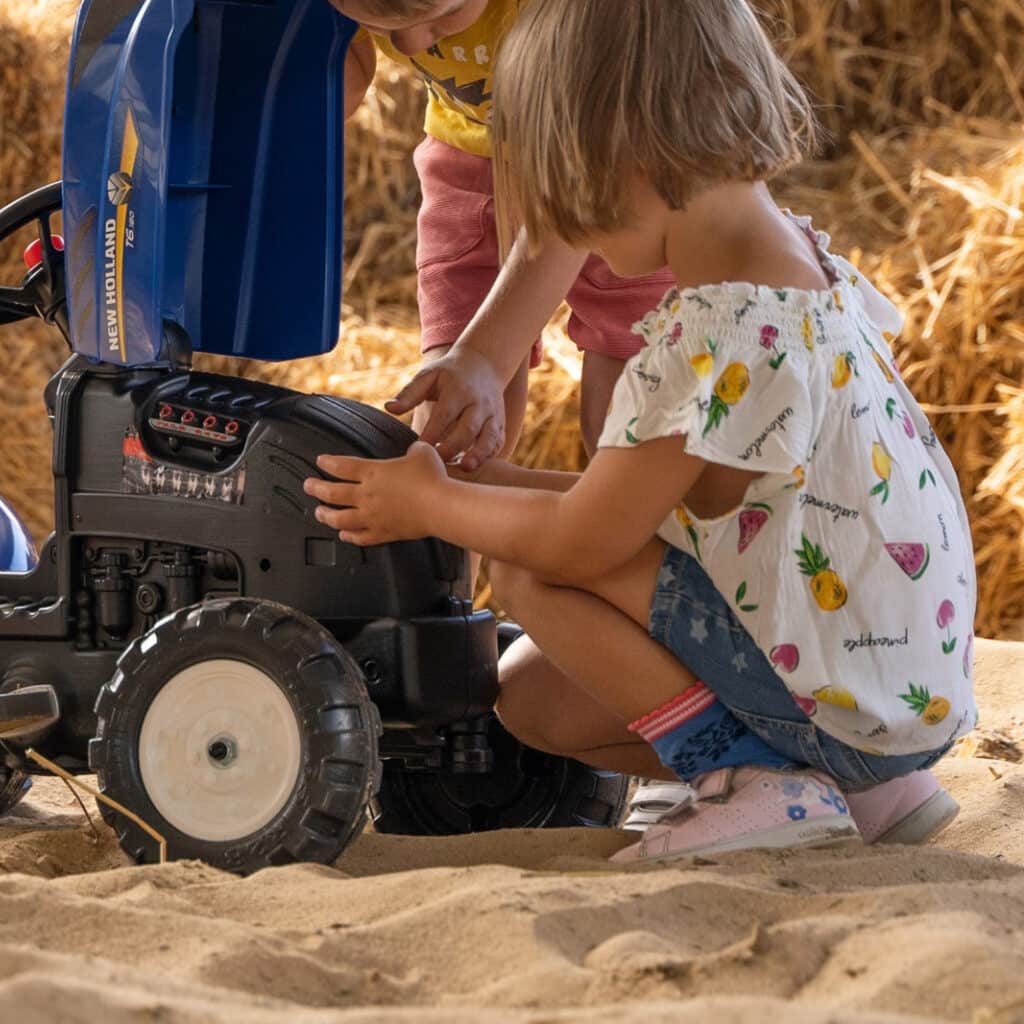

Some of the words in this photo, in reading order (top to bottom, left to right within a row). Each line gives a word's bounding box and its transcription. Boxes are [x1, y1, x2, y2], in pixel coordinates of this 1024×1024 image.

[105, 218, 116, 304] HOLLAND
[107, 310, 119, 352] NEW
[737, 407, 794, 460] watermelon
[842, 627, 909, 653] pineapple
